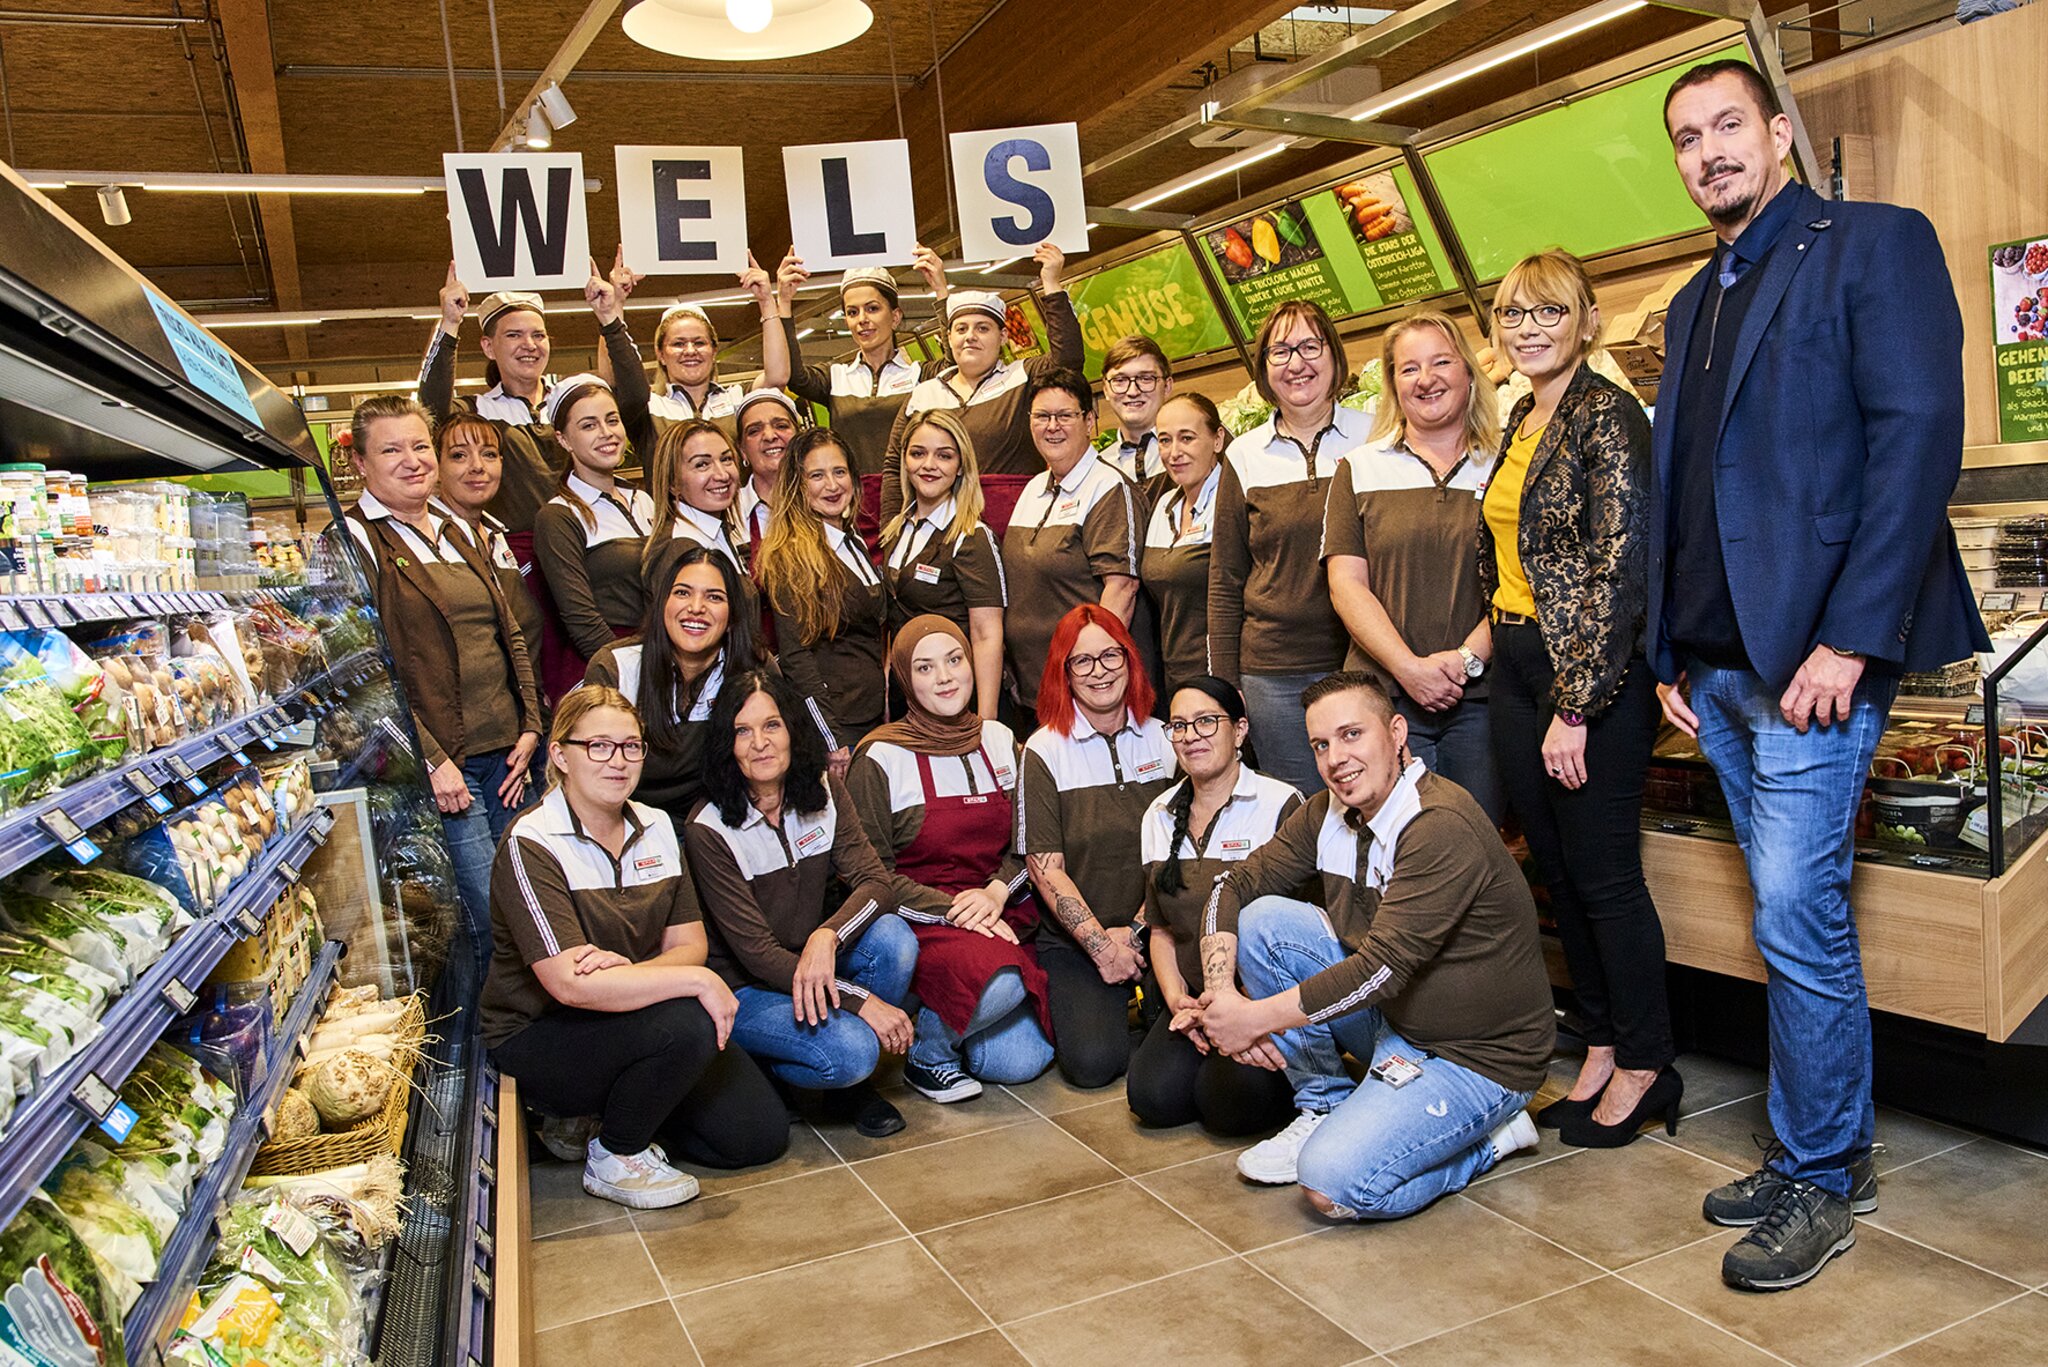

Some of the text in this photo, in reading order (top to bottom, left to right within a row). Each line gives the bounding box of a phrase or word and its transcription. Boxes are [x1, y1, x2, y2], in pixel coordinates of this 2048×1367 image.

[1367, 245, 1426, 270] ÖSTERREICH-LIGA
[1378, 239, 1400, 253] STARS
[1401, 234, 1417, 246] DER
[1240, 263, 1321, 294] DIE TRICOLORE MACHEN
[1245, 274, 1325, 305] UNSERE KÜCHE BUNTER
[1078, 282, 1195, 351] GEMÜSE
[2027, 423, 2043, 433] und
